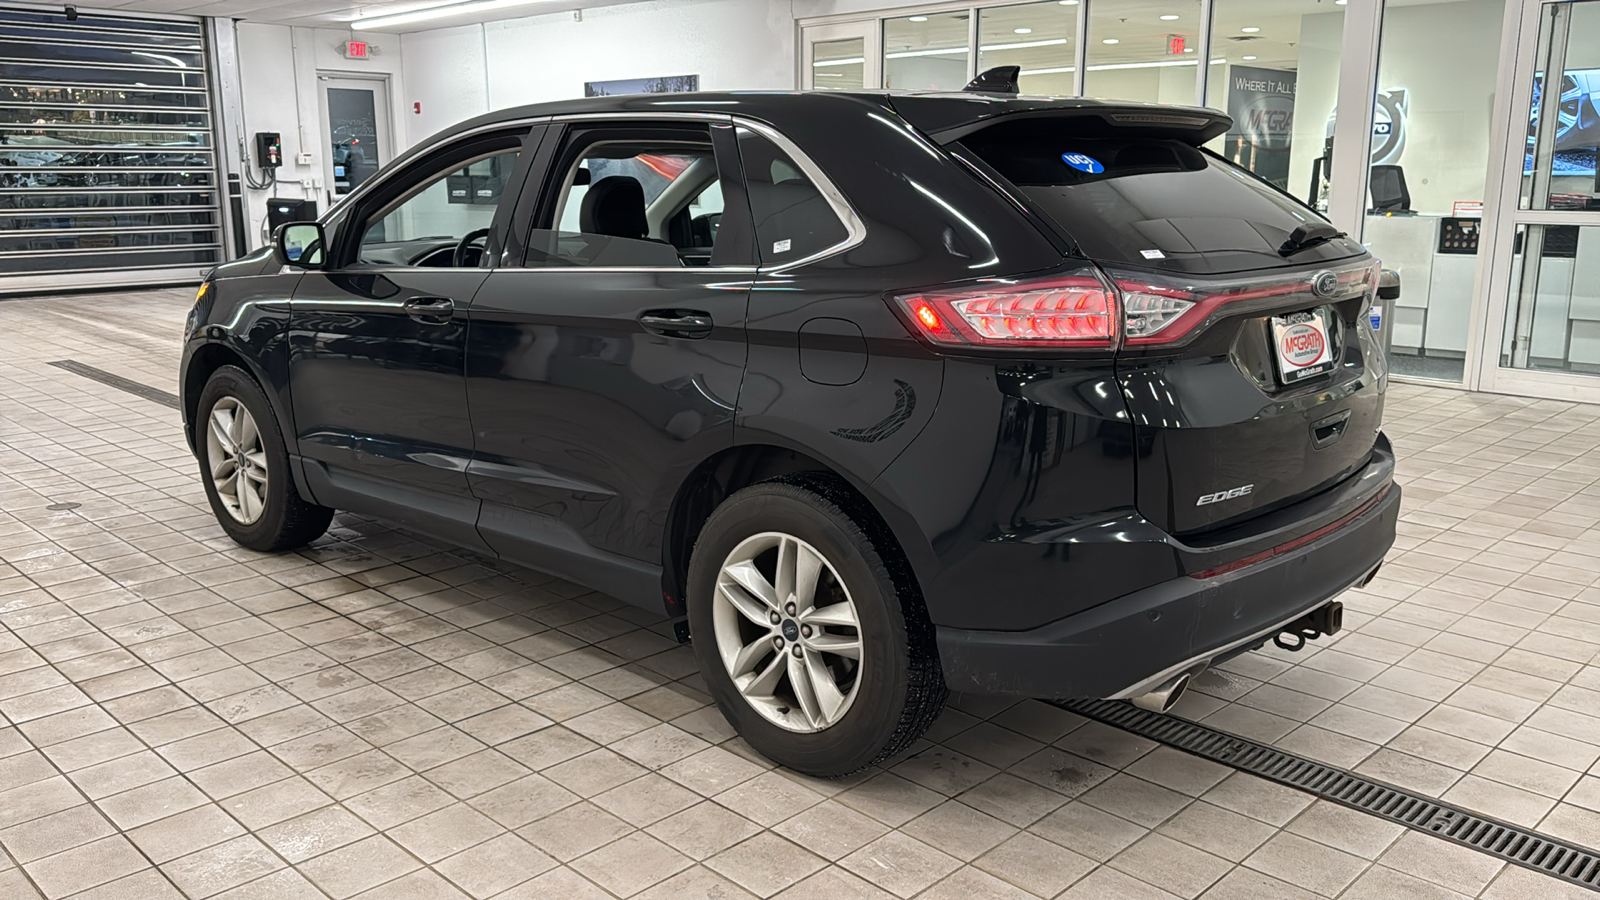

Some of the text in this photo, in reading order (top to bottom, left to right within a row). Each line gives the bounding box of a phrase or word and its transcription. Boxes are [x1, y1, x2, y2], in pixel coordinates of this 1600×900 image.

[349, 41, 367, 57] EXIT
[1171, 37, 1185, 55] EXIT
[1196, 483, 1254, 506] EDGE
